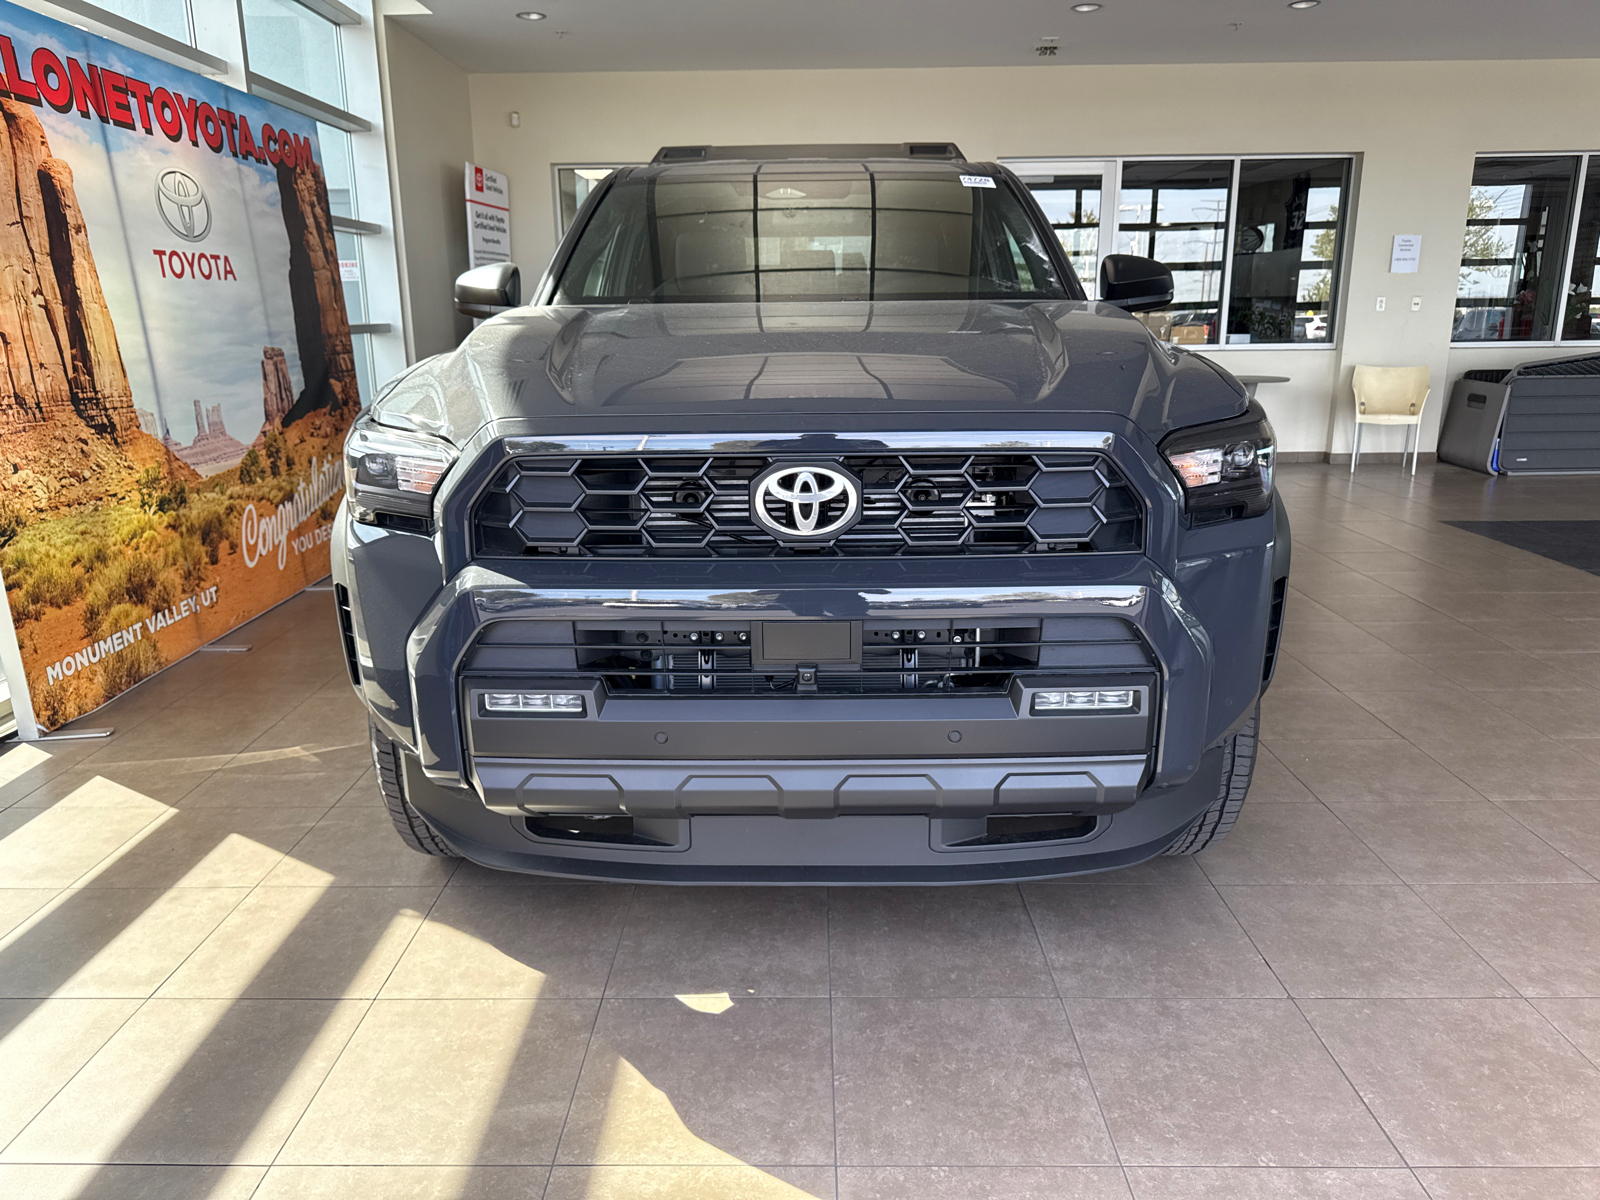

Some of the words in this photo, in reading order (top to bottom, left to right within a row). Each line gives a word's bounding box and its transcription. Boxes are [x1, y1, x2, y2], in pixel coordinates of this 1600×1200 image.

[0, 34, 315, 174] LONETOYOTA.COM
[1289, 210, 1305, 231] 32
[152, 248, 238, 282] TOYOTA
[291, 532, 314, 555] YOU
[46, 622, 143, 686] MONUMENT
[145, 595, 201, 635] VALLEY,
[200, 586, 219, 606] UT
